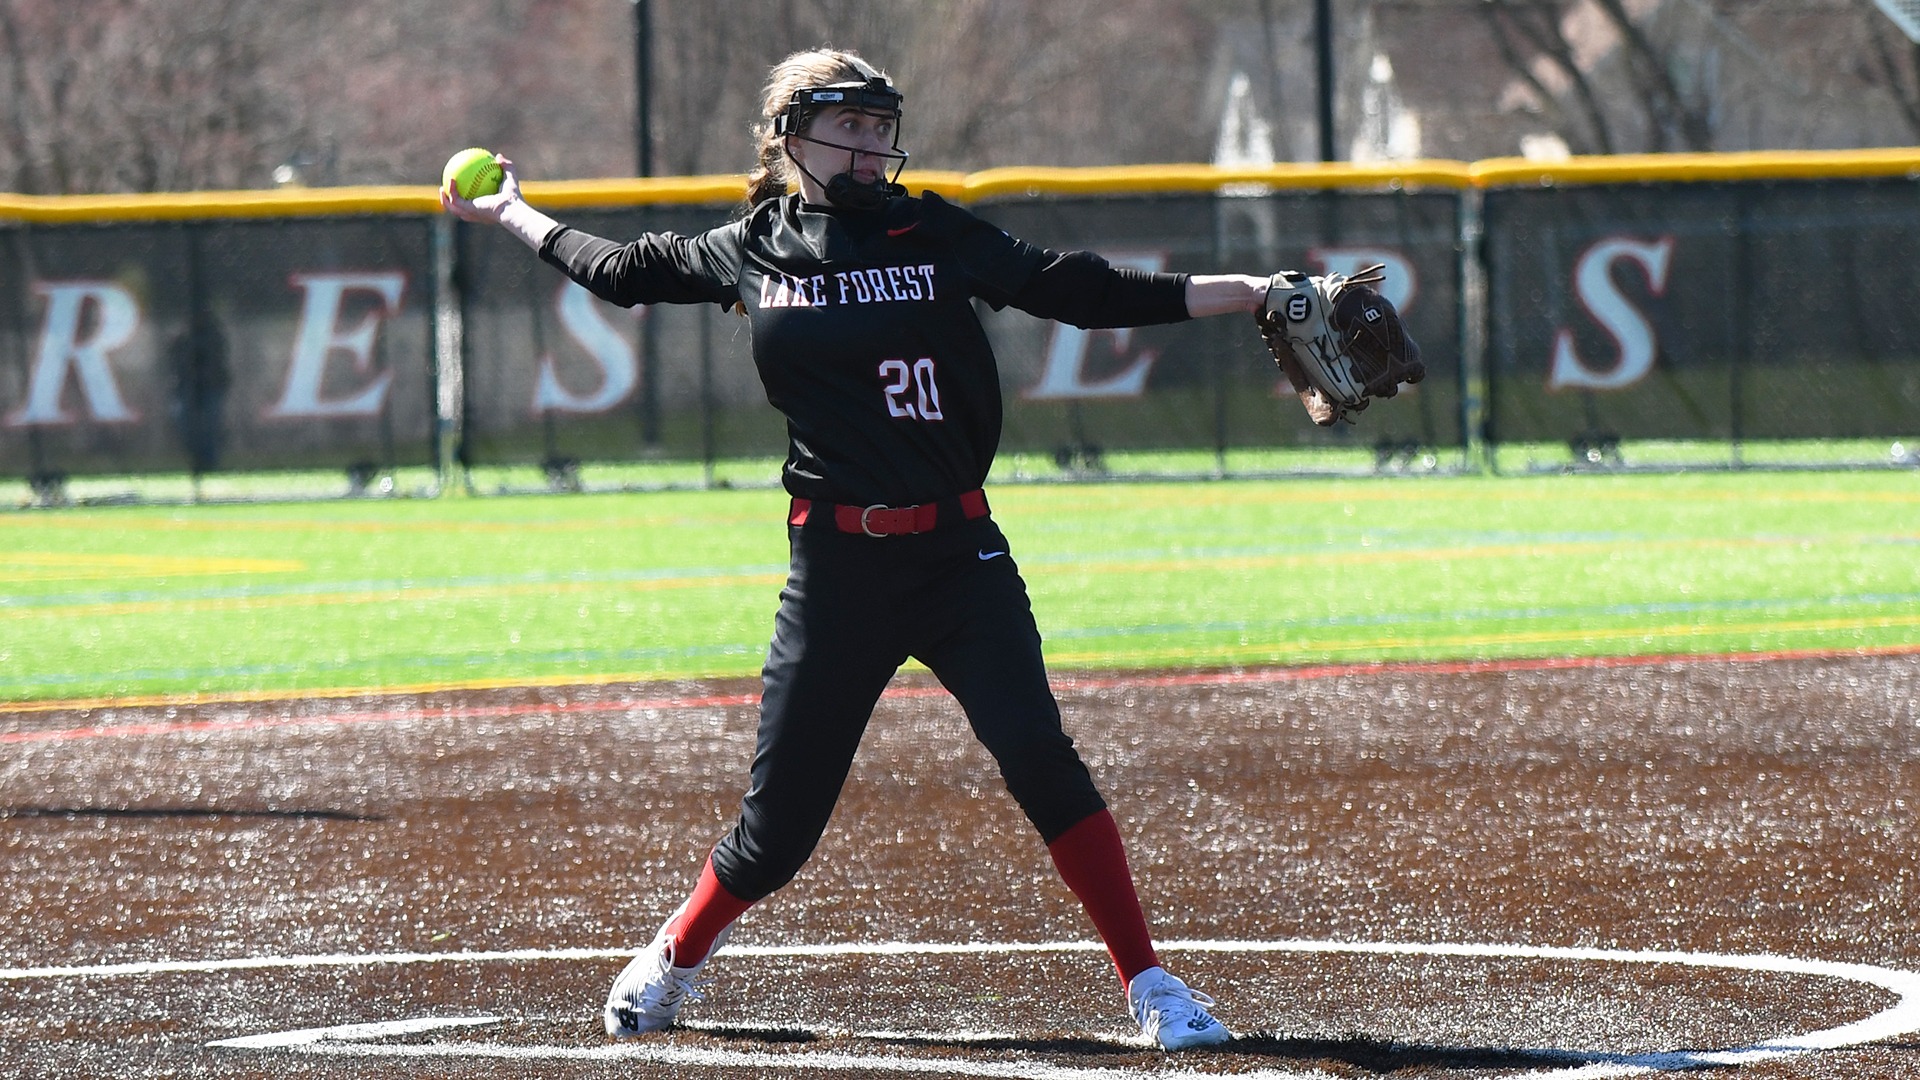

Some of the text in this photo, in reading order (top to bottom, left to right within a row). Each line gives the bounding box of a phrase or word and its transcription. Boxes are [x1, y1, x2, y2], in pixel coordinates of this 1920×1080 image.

[758, 263, 936, 309] LAKE FOREST
[878, 357, 944, 421] 20
